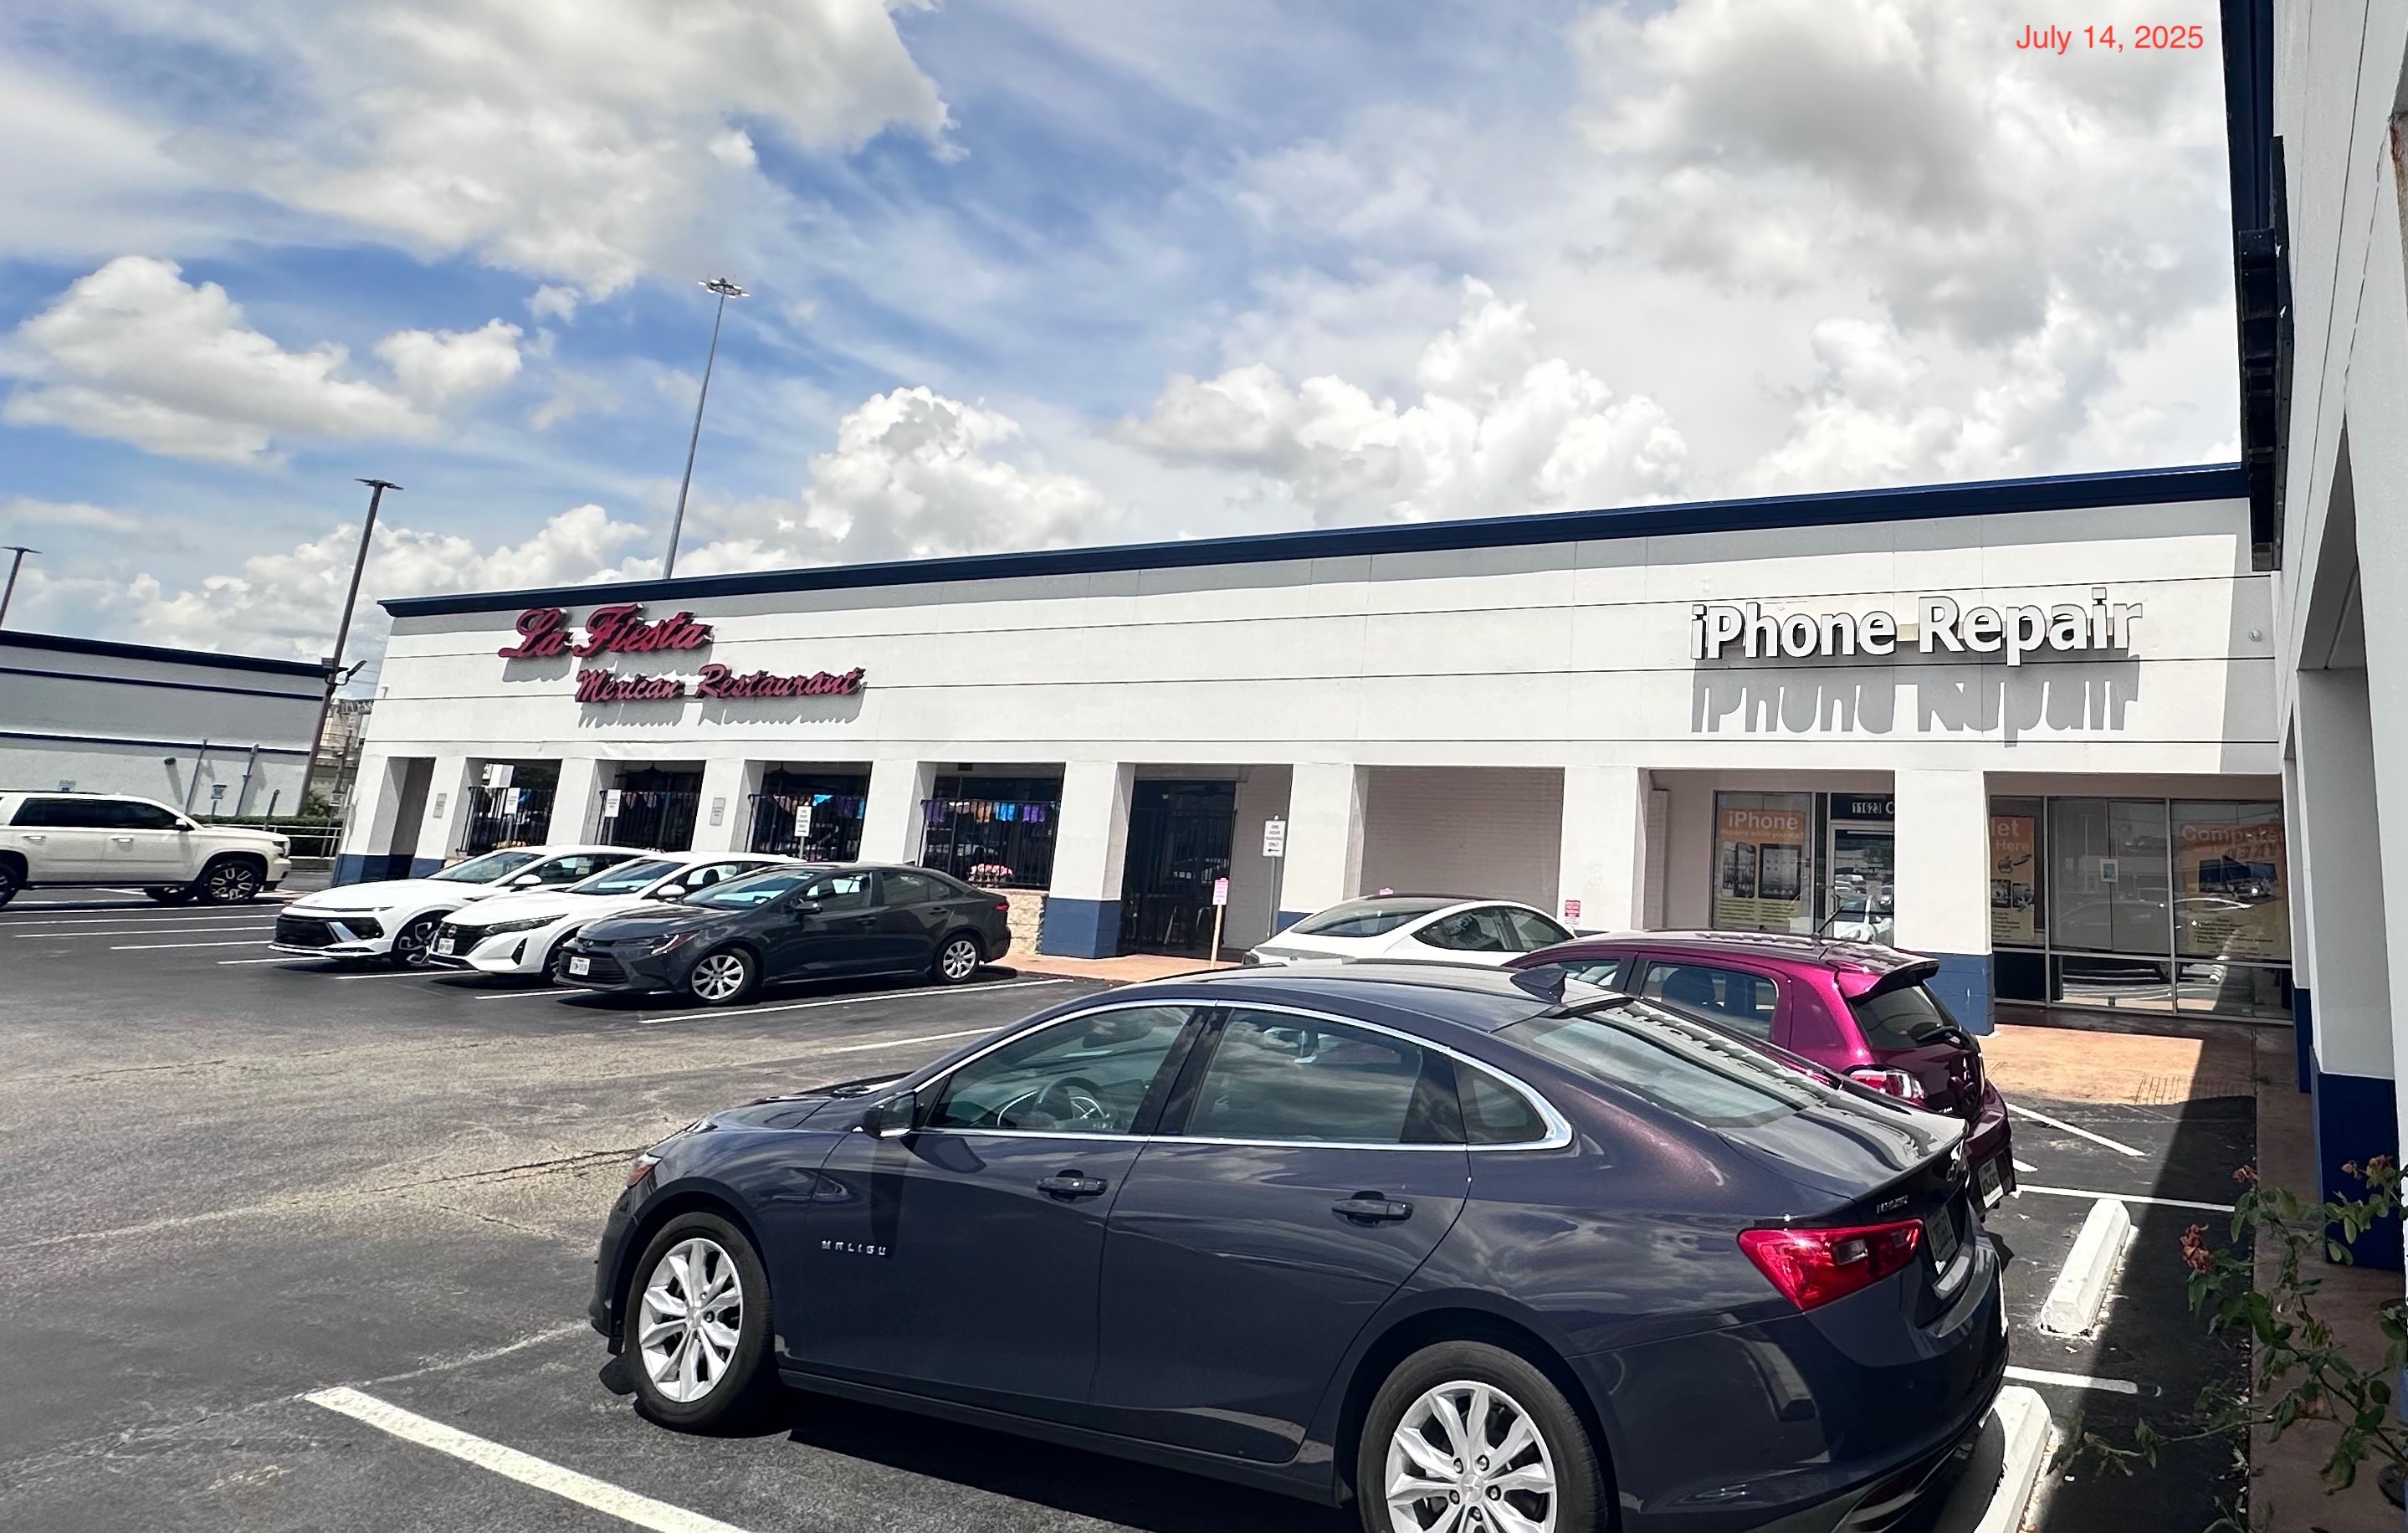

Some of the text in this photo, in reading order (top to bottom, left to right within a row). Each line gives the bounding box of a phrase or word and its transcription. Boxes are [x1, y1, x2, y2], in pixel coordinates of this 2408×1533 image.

[498, 602, 715, 658] La Fiesta
[1690, 587, 2143, 666] iPhone Repair
[575, 663, 866, 703] Mexican Restaurant
[1728, 811, 1799, 830] iPhone
[1996, 839, 2030, 852] Here
[821, 1239, 887, 1256] MALIBU
